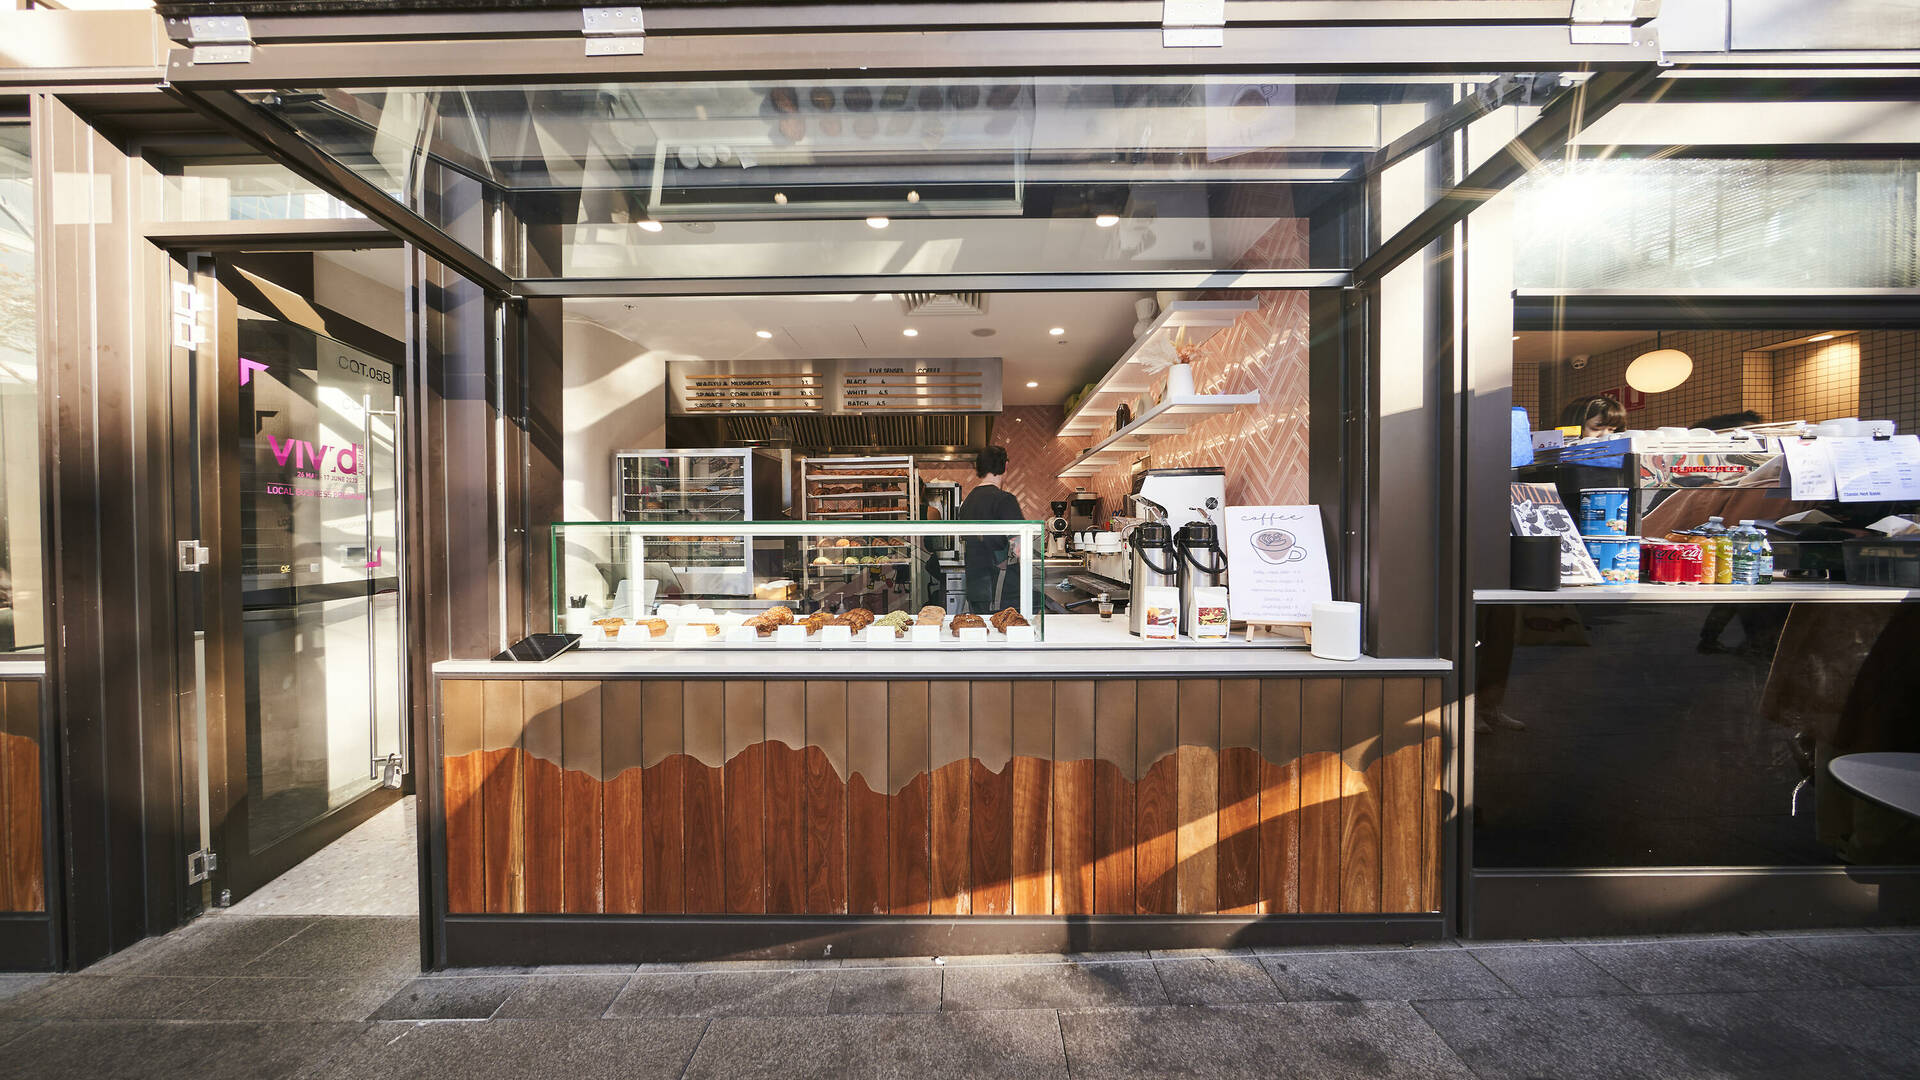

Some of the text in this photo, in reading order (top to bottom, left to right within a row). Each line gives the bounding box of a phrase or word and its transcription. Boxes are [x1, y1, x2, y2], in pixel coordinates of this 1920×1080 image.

[266, 485, 294, 496] LOCAL
[1510, 484, 1561, 505] WILL
[1240, 512, 1305, 526] coffee
